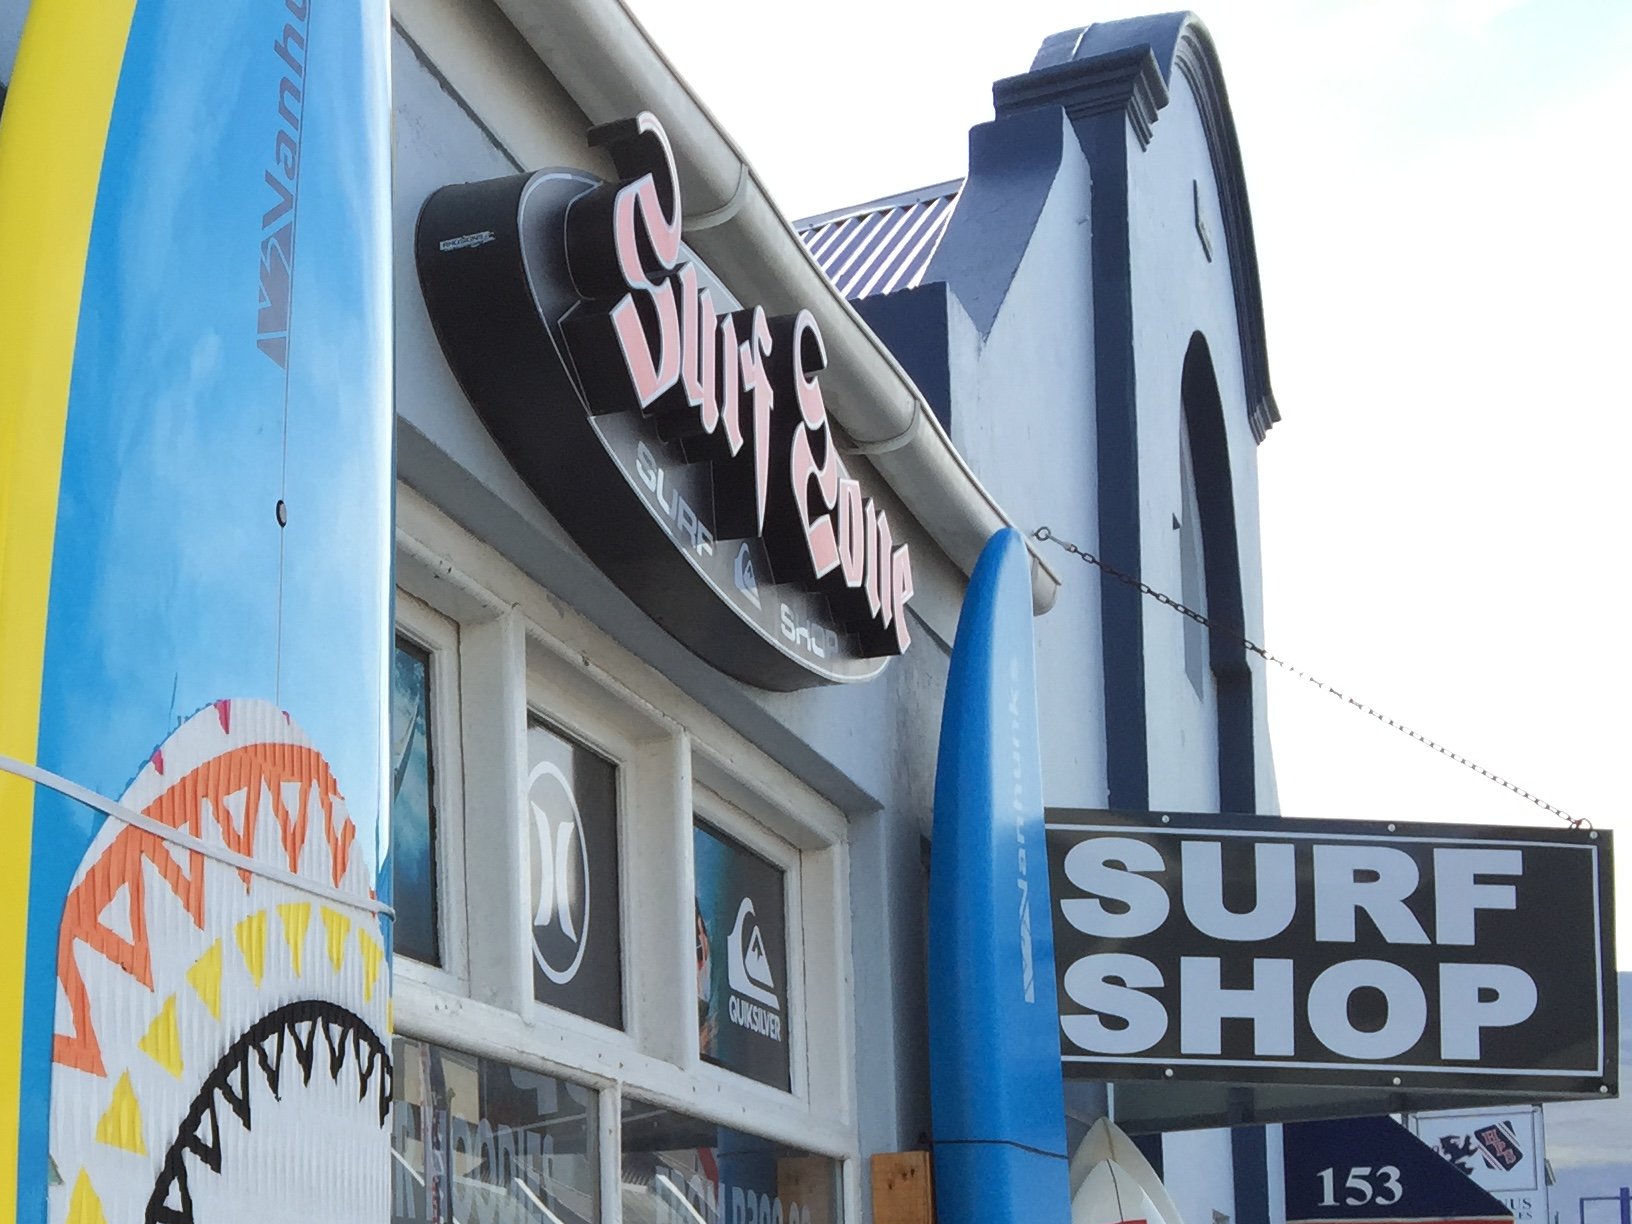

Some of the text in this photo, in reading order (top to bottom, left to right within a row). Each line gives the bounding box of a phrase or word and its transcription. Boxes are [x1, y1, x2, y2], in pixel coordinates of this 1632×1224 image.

[635, 440, 839, 660] SURF SHOP
[1060, 837, 1524, 946] SURF
[729, 995, 782, 1043] QUIKSILVER
[1060, 952, 1539, 1061] SHOP
[1316, 1164, 1404, 1207] 153
